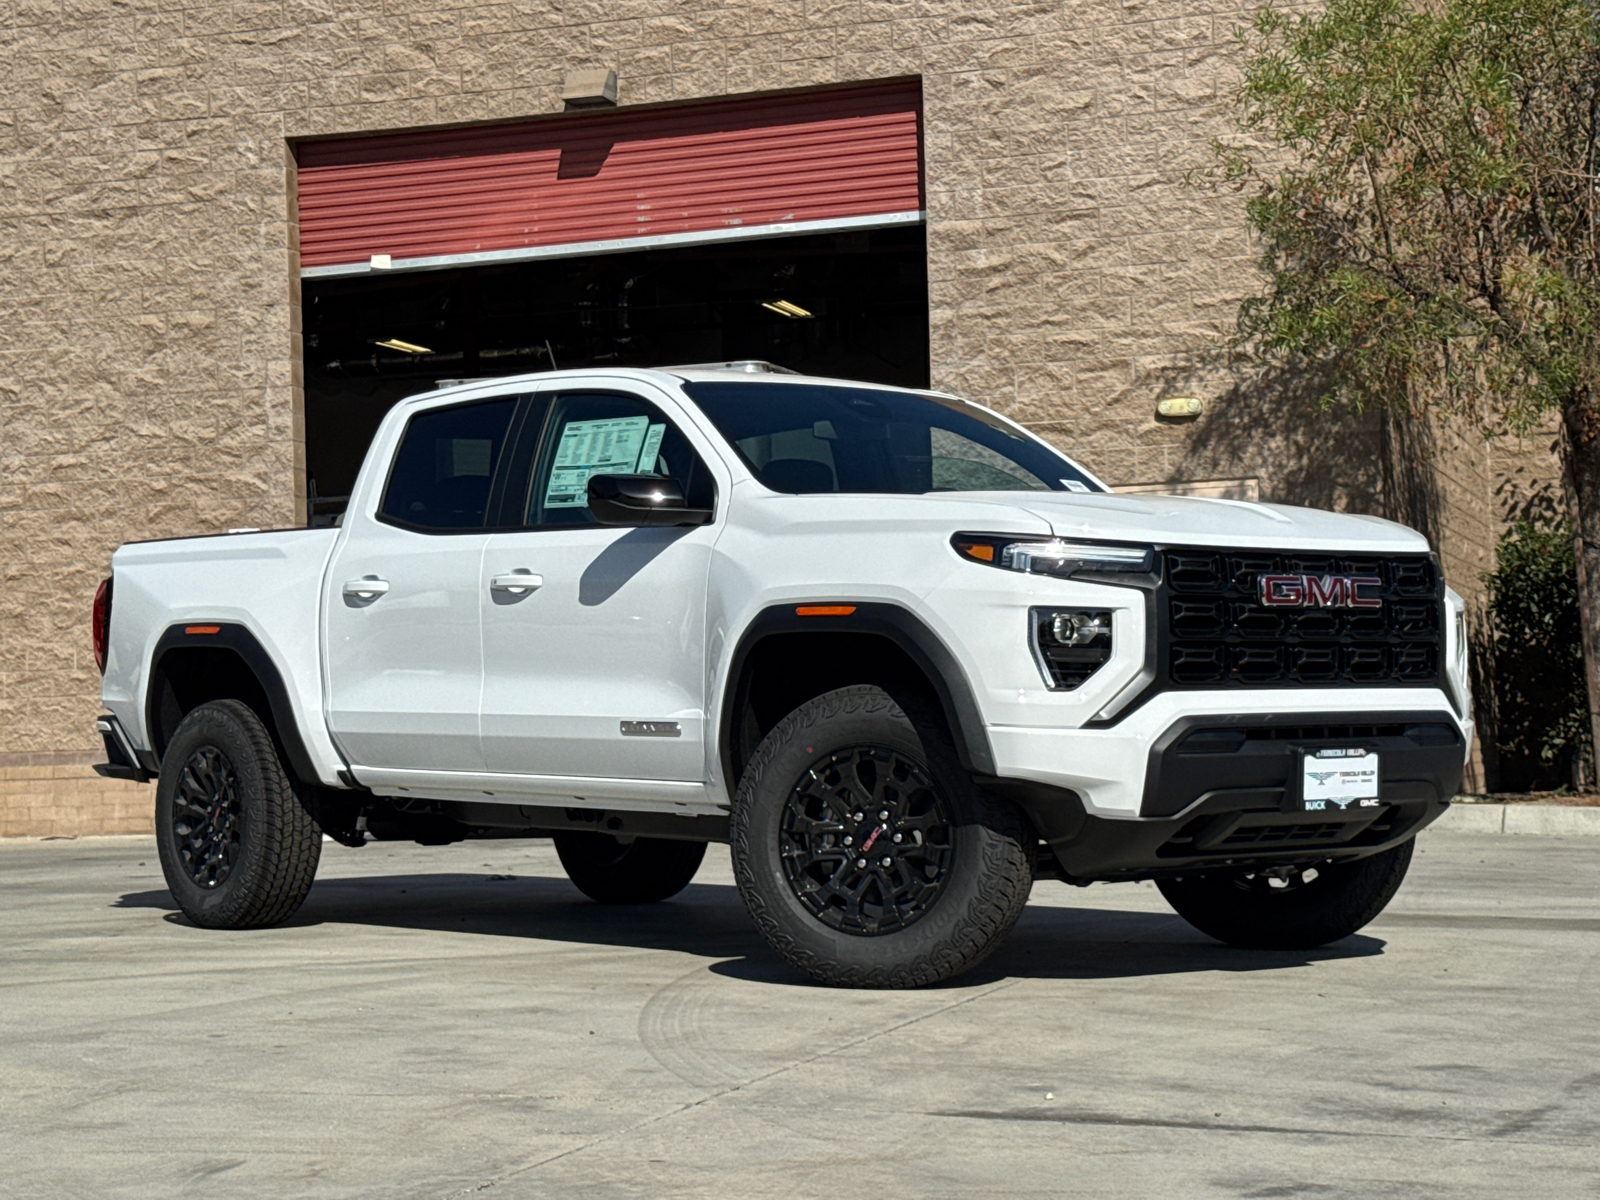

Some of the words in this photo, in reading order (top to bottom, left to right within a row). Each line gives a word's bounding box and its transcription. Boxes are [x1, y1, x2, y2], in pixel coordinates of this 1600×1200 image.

[1261, 575, 1382, 608] GMC
[1305, 801, 1326, 810] BUICK
[1360, 799, 1379, 807] GMC
